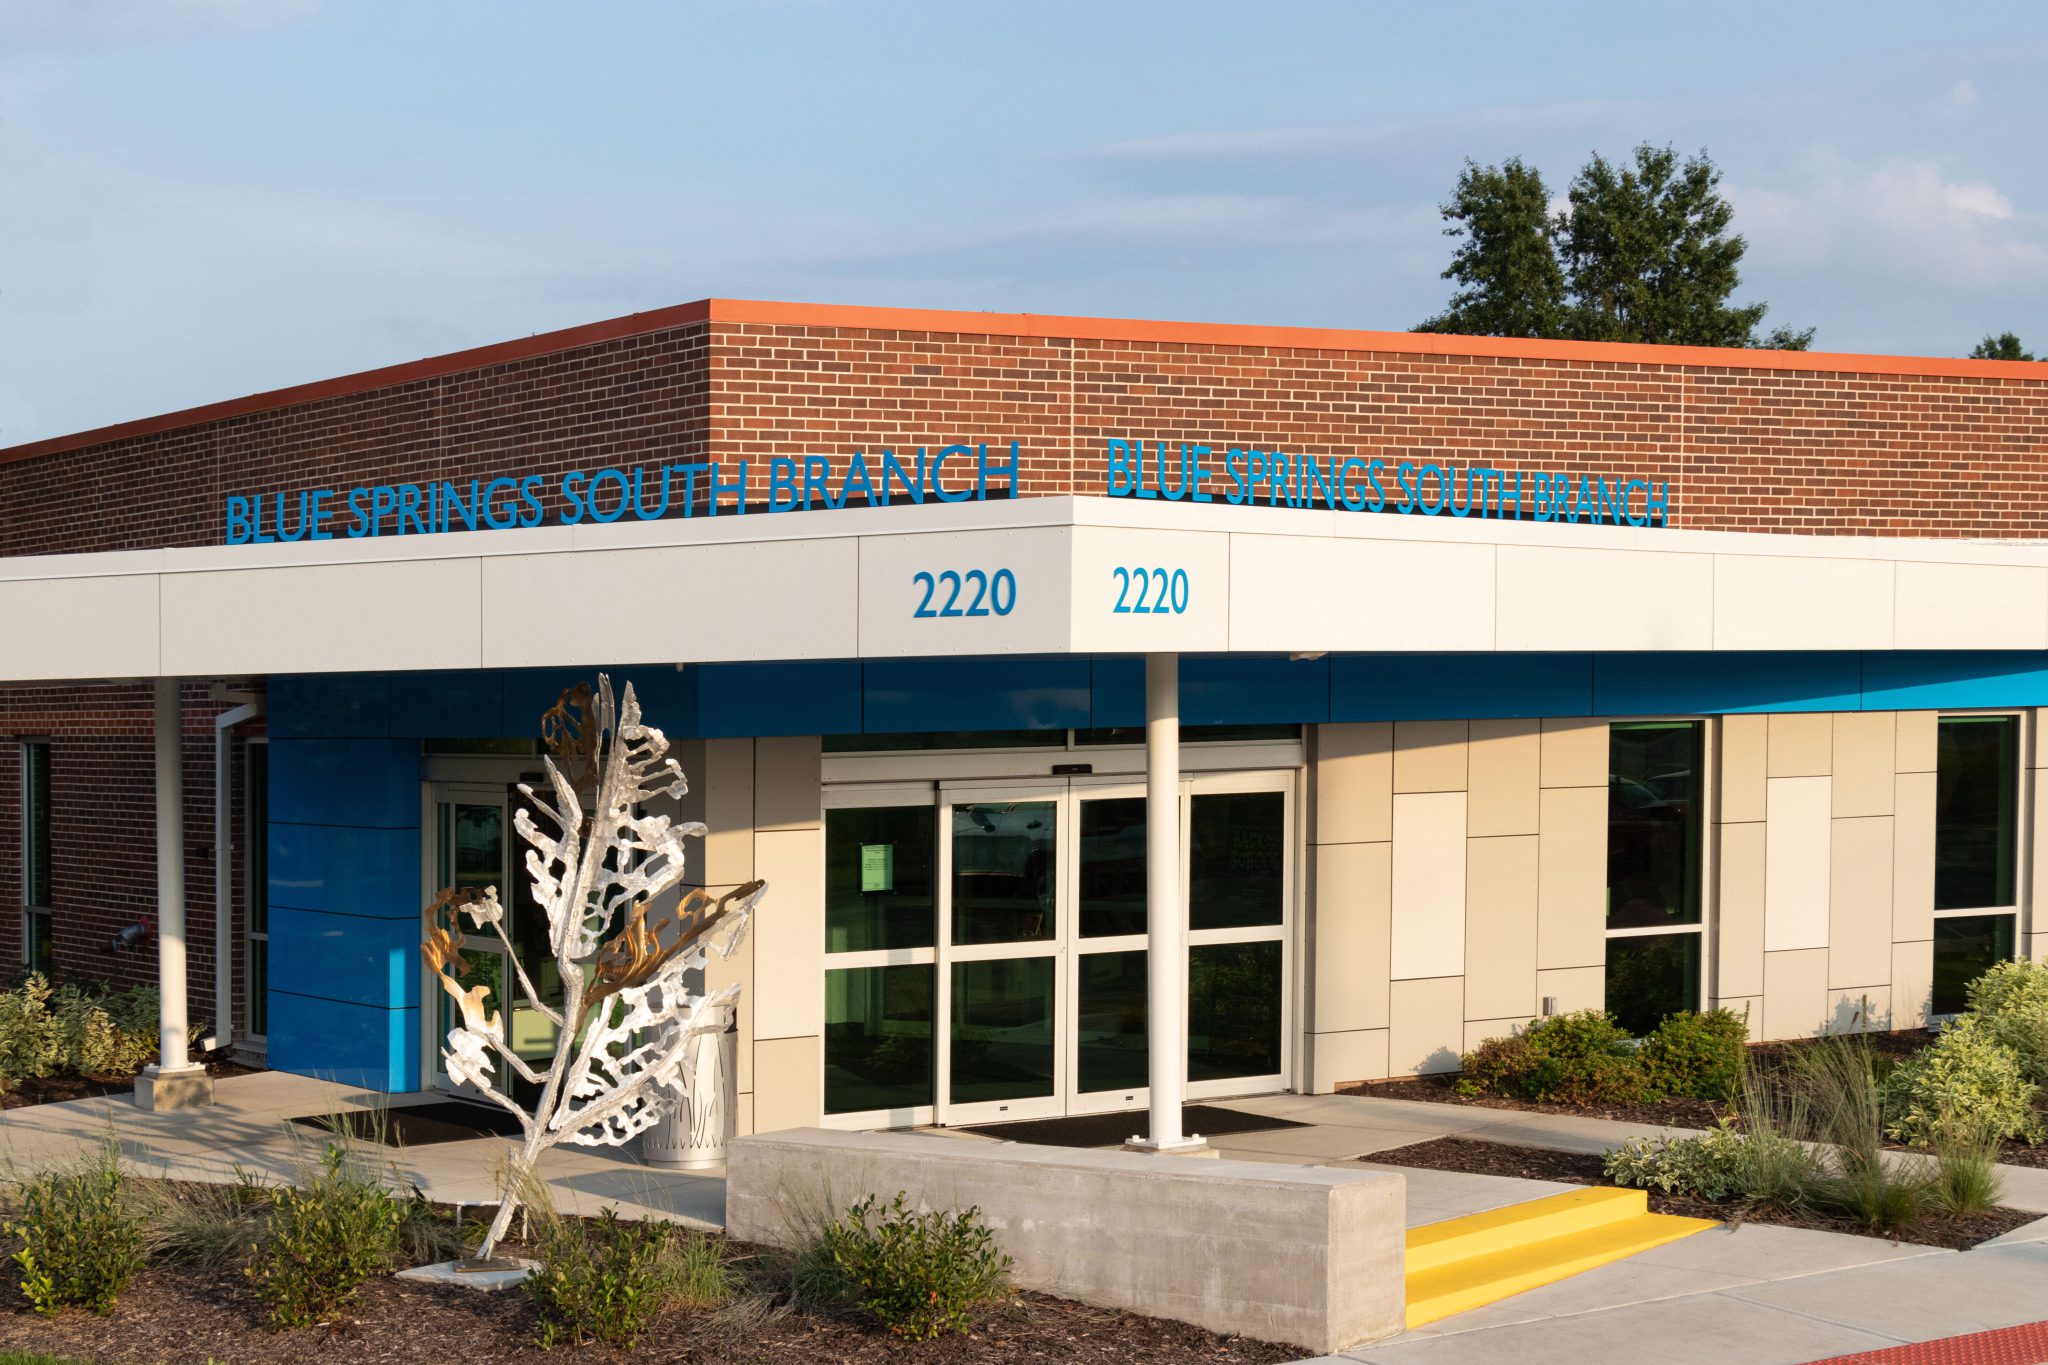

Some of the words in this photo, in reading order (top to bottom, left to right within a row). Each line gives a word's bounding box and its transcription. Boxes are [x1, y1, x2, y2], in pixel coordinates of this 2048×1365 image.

[226, 489, 334, 546] BLUE
[347, 474, 544, 538] SPRINGS
[559, 459, 748, 526] SOUTH
[767, 441, 1019, 514] BRANCH
[1107, 438, 1213, 503] BLUE
[1225, 447, 1386, 513] SPRINGS
[1396, 461, 1522, 521] SOUTH
[1533, 472, 1669, 529] BRANCH
[913, 568, 1017, 619] 2220
[1112, 566, 1189, 615] 2220
